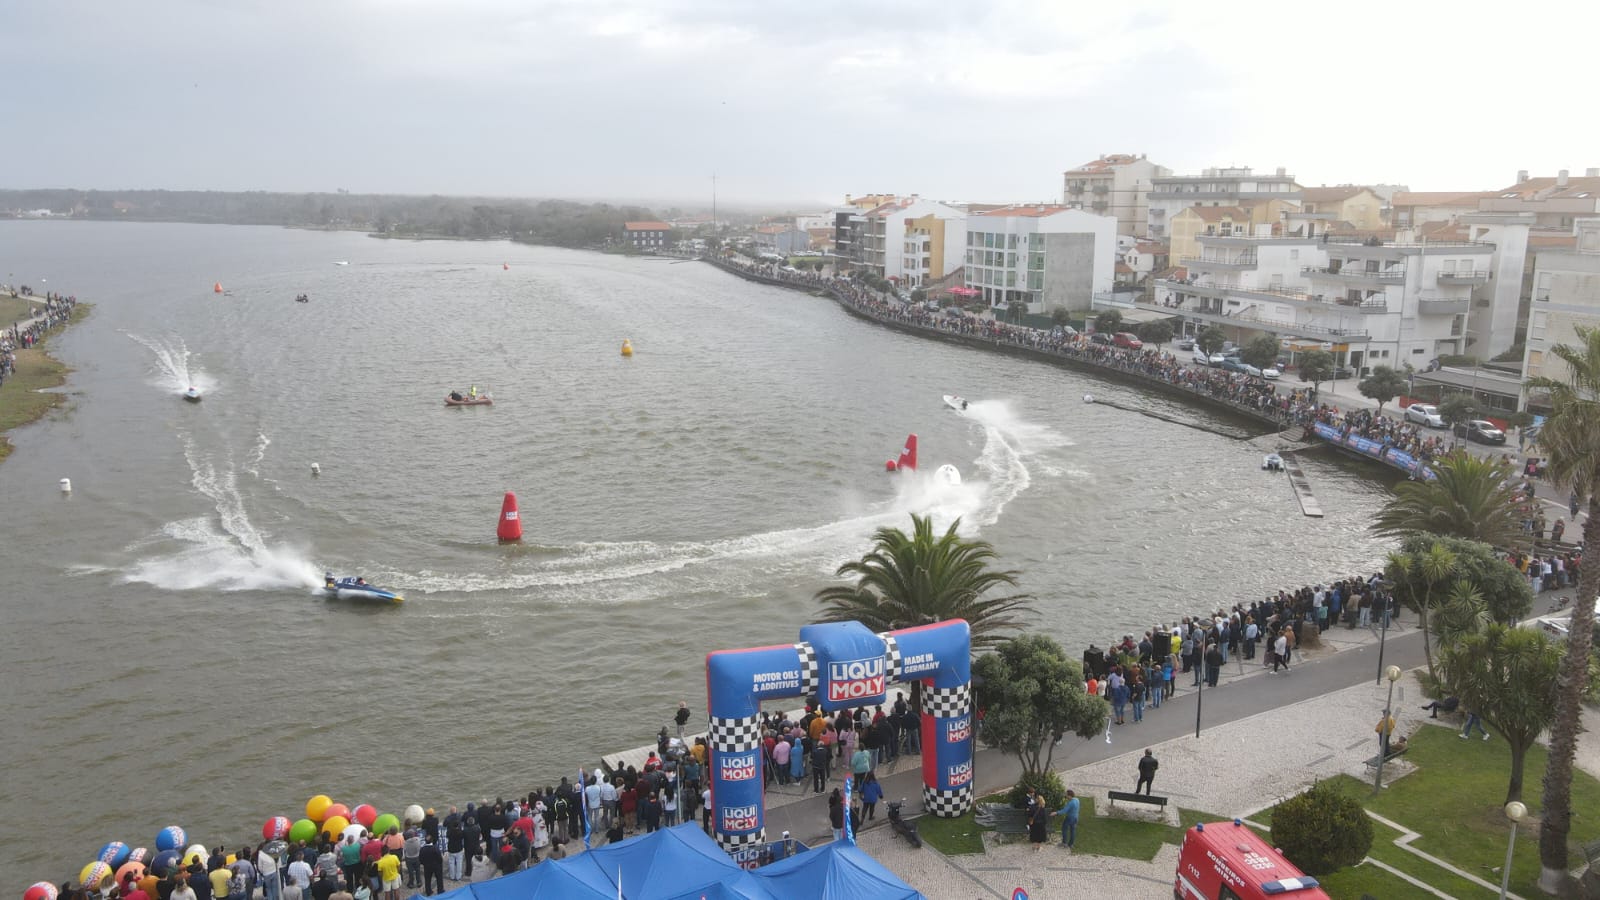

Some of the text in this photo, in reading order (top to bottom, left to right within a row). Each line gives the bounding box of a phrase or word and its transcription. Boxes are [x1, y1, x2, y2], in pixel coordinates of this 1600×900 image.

[904, 653, 933, 665] MADE IN
[832, 658, 883, 681] LIQUI
[904, 661, 940, 673] GERMANY
[754, 670, 799, 682] MOTOR OILS
[753, 680, 799, 692] & ADDITIVES
[832, 676, 884, 699] MOLY
[722, 756, 754, 768] LIQUI
[722, 767, 755, 779] MOLY
[724, 806, 756, 818] LIQUI
[724, 818, 757, 829] MOLY
[1190, 865, 1200, 879] 112
[1206, 851, 1246, 887] BOMBEIROS
[1214, 865, 1234, 886] MIRA
